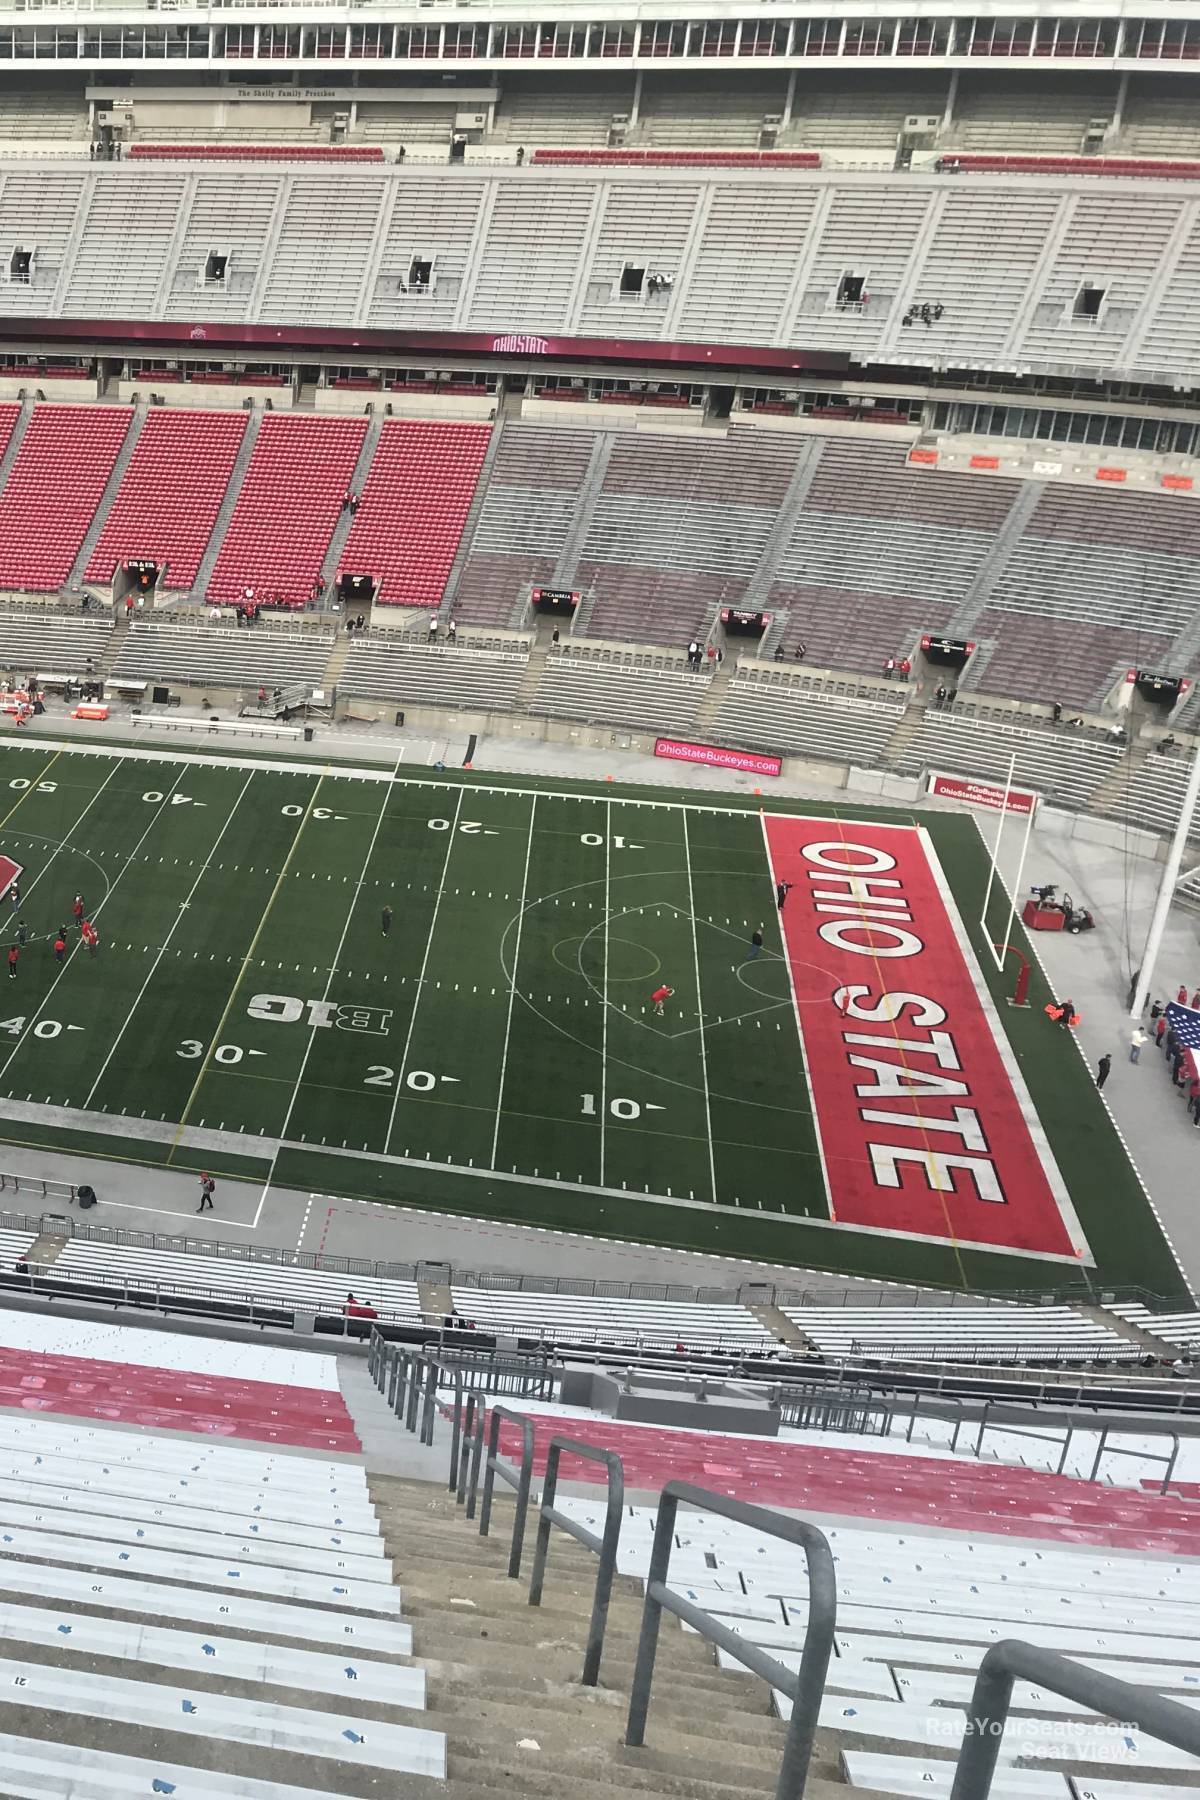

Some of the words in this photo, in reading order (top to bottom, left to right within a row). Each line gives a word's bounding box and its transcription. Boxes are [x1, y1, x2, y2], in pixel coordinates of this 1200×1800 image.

[657, 743, 779, 772] OhioStateBuckeyes.com
[9, 778, 58, 794] 50
[966, 784, 1004, 799] #GoBucks
[142, 790, 194, 807] 40
[281, 803, 335, 820] 30
[427, 817, 483, 835] 20
[580, 832, 629, 850] 10
[801, 840, 925, 959] OHIO
[175, 1039, 245, 1065] 30
[363, 1065, 436, 1092] 20
[832, 984, 1008, 1204] STATE
[580, 1093, 641, 1120] 10
[91, 1585, 104, 1593] 20
[14, 1676, 27, 1687] 21
[922, 1773, 935, 1782] 17
